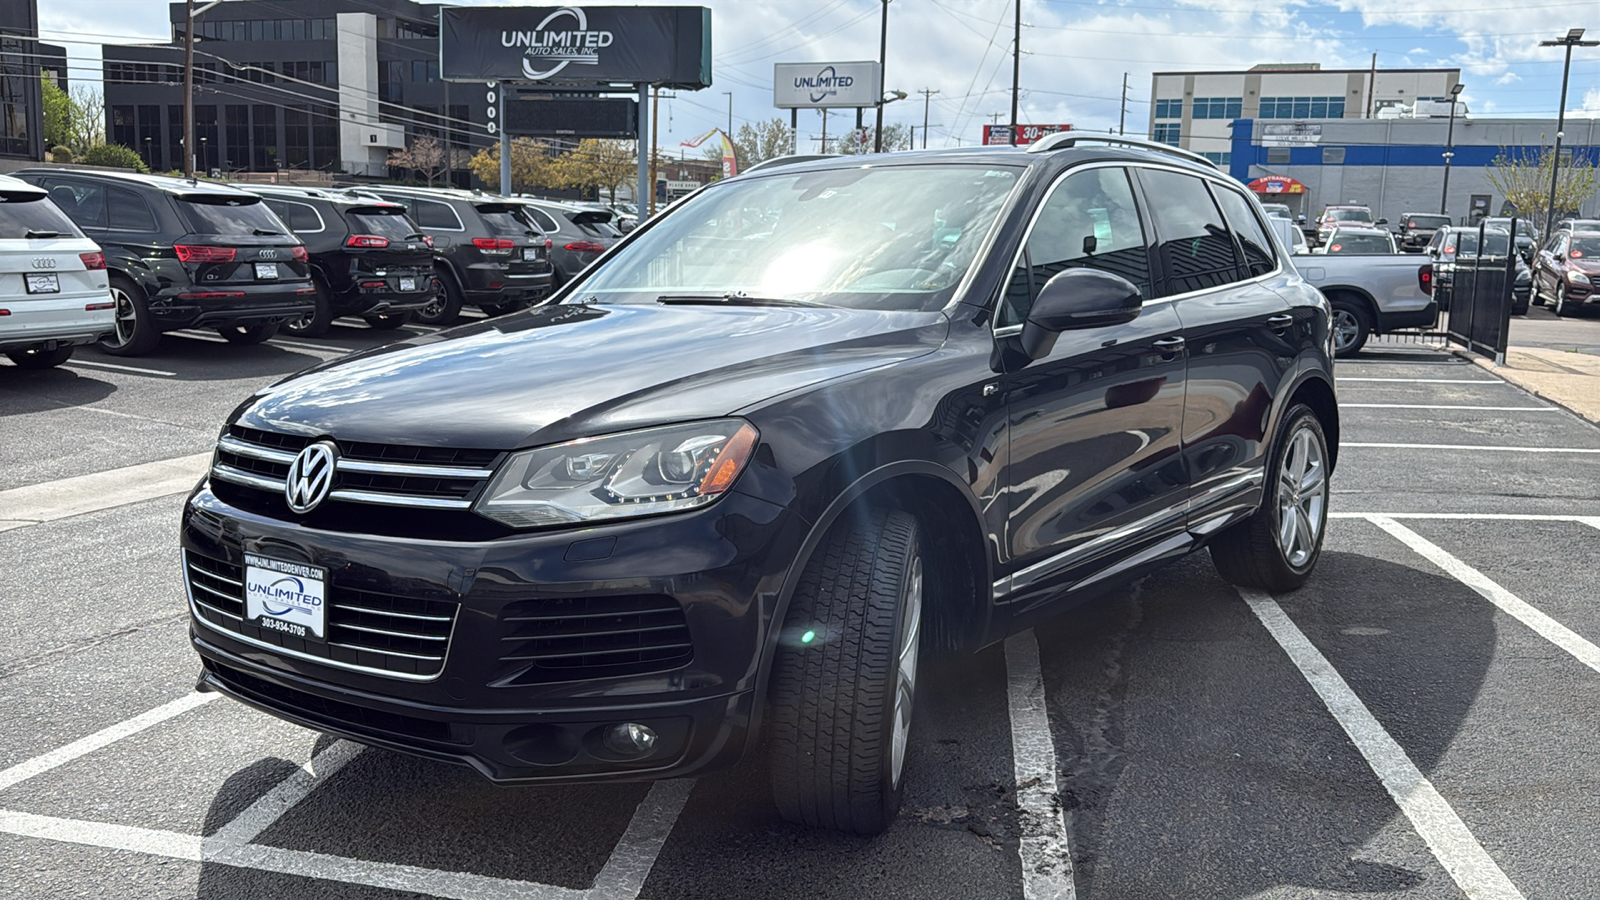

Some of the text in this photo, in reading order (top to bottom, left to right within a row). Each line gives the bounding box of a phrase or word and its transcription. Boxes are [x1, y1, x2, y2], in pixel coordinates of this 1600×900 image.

[501, 31, 613, 47] UNLIMITED
[524, 47, 598, 56] AUTO SALES, INC.
[794, 76, 854, 88] UNLIMITED
[1260, 175, 1292, 183] ENTRANCE
[244, 554, 323, 580] WWW.UNLIMITEDDENVER.COM
[248, 582, 322, 606] UNLIMITED
[261, 617, 306, 637] 303-934-3705
